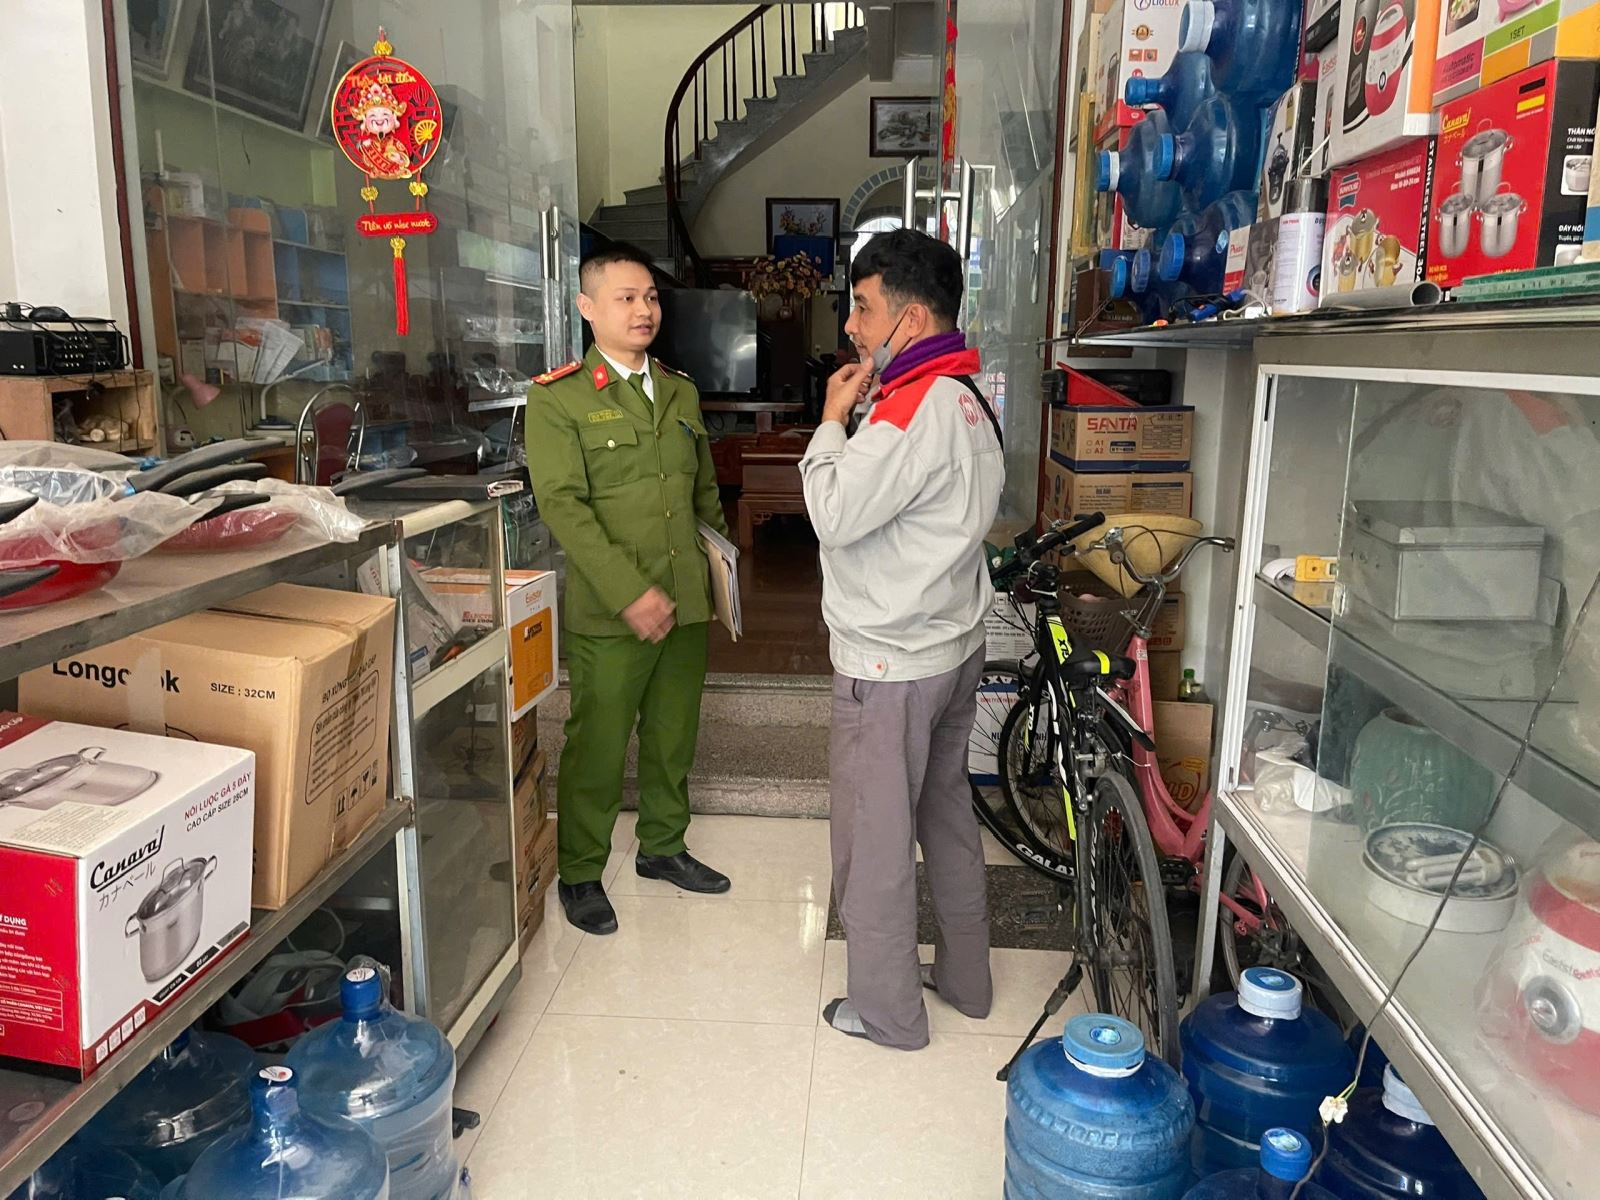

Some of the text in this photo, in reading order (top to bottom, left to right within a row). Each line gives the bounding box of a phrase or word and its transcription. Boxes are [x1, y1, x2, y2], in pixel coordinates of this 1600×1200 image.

[1418, 215, 1428, 255] STEEL
[1087, 417, 1138, 430] SANTA
[52, 661, 180, 693] Longck
[210, 682, 236, 695] SIZE
[244, 688, 276, 700] 32CM
[184, 804, 198, 821] NỒI
[199, 792, 219, 813] LUỘC
[220, 781, 232, 797] GÀ
[237, 772, 251, 785] ĐÁY
[186, 817, 202, 832] CAO
[203, 806, 217, 822] CẤP
[217, 799, 232, 814] SIZE
[90, 824, 165, 893] Canaval
[99, 861, 156, 912] カナベール
[4, 915, 27, 926] DỤNG
